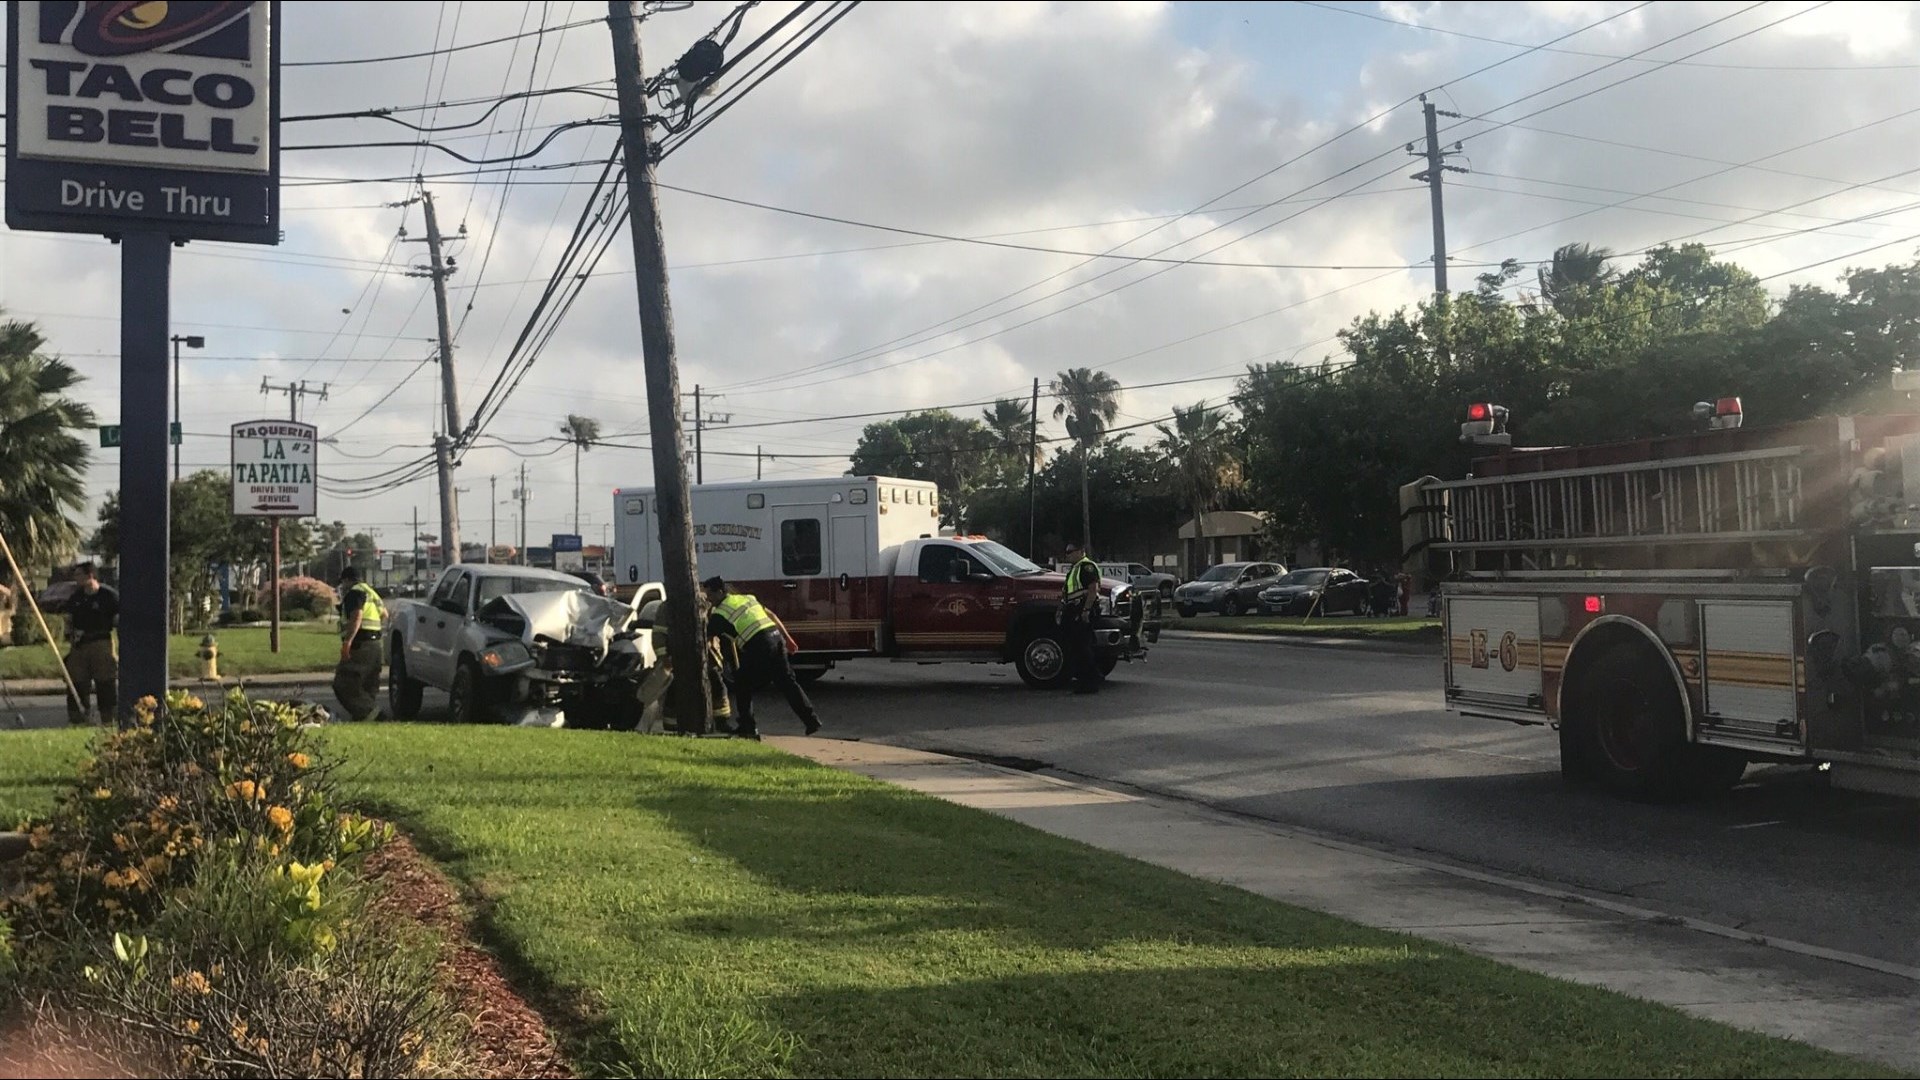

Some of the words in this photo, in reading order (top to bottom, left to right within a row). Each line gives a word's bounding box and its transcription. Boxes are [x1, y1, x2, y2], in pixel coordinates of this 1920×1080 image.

[29, 58, 255, 109] TACO
[47, 105, 259, 154] BELL
[61, 179, 144, 210] Drive
[160, 186, 231, 216] Thru
[236, 426, 313, 439] TAQUERIA
[263, 439, 286, 459] LA
[292, 442, 310, 453] #2
[236, 463, 312, 483] TAPATIA
[250, 485, 274, 494] DRIVE
[278, 485, 299, 494] THRU
[258, 494, 291, 503] SERVICE
[703, 541, 747, 553] RESCUE
[1470, 628, 1518, 672] E-6
